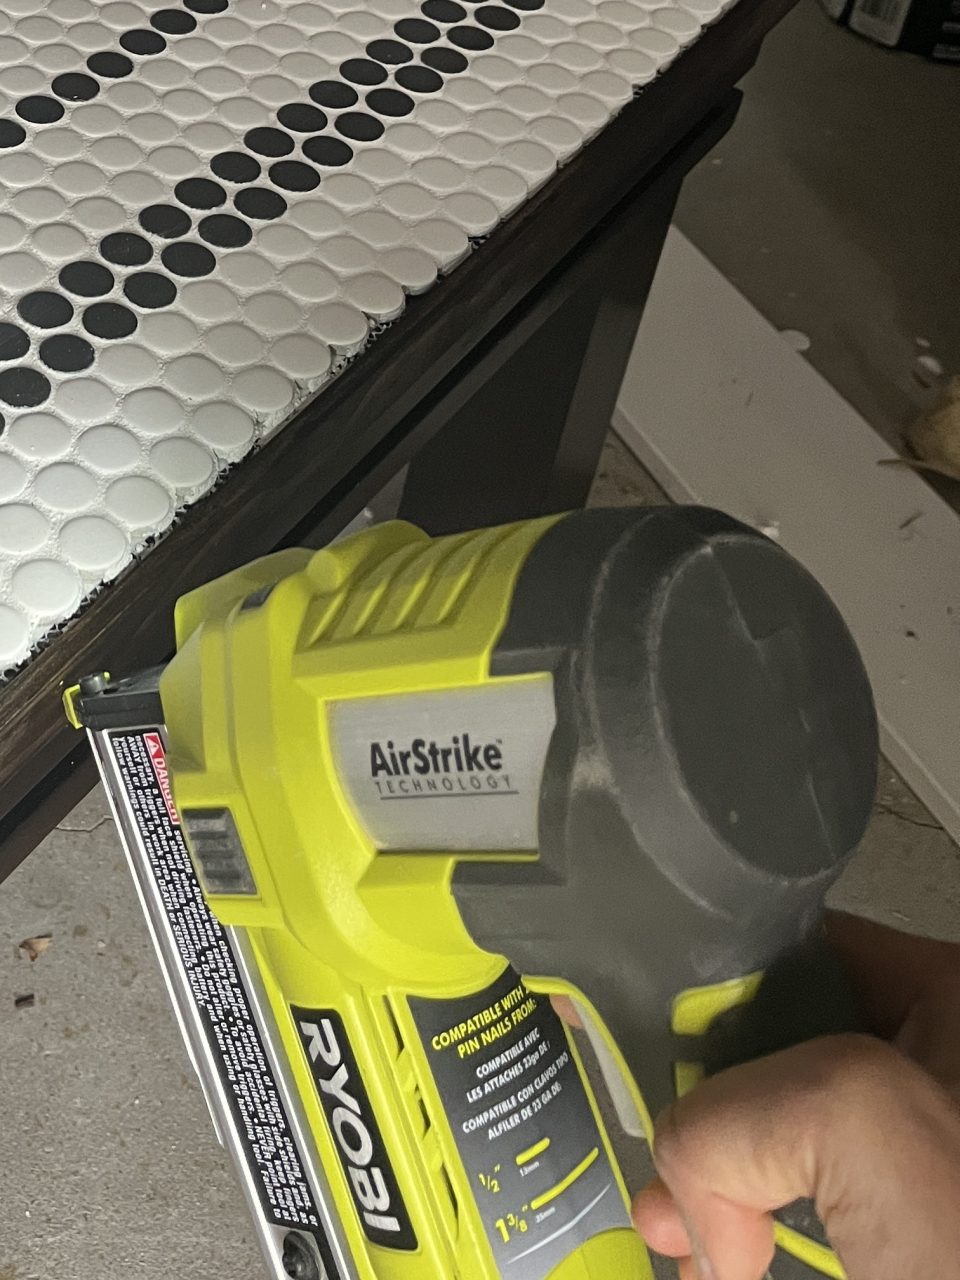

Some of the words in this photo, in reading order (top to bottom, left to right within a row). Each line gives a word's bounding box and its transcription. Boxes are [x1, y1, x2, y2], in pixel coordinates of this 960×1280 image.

[112, 737, 125, 765] follow
[121, 767, 139, 809] warnings
[135, 811, 150, 836] could
[144, 838, 159, 865] result
[154, 867, 161, 877] in
[158, 878, 174, 910] DEATH
[168, 912, 176, 923] or
[172, 924, 192, 967] SERIOUS
[375, 774, 513, 795] TECHNOLOGY
[117, 736, 137, 773] yourself
[132, 776, 140, 786] or
[136, 789, 150, 818] others
[147, 821, 154, 830] in
[151, 833, 164, 856] work
[159, 859, 170, 880] area
[167, 883, 180, 909] when
[176, 911, 197, 963] connecting
[194, 966, 210, 1000] battery
[206, 1003, 218, 1022] and
[213, 1024, 226, 1051] when
[223, 1054, 236, 1081] using
[232, 1084, 241, 1095] or
[237, 1097, 255, 1140] handling
[261, 1170, 276, 1205] Failure
[273, 1208, 281, 1218] to
[127, 736, 142, 763] AWAY
[136, 765, 148, 786] from
[144, 788, 160, 824] triggers
[156, 826, 169, 852] when
[165, 853, 176, 869] not
[171, 870, 186, 904] driving
[201, 963, 210, 977] Do
[206, 979, 218, 995] not
[212, 996, 224, 1020] alter
[220, 1022, 228, 1032] or
[224, 1034, 241, 1071] remove
[254, 1125, 271, 1159] NEVER
[264, 1161, 280, 1187] point
[275, 1188, 287, 1208] tool
[282, 1209, 291, 1220] at
[155, 797, 166, 813] full
[161, 816, 172, 837] face
[169, 840, 184, 869] shield
[180, 872, 192, 898] when
[189, 901, 208, 947] operating
[205, 950, 216, 969] this
[230, 1026, 238, 1037] To
[235, 1040, 249, 1068] avoid
[245, 1071, 267, 1122] accidental
[274, 1159, 286, 1184] keep
[283, 1187, 298, 1222] fingers
[432, 1003, 503, 1050] COMPATIBLE
[501, 986, 524, 1011] WITH
[457, 1037, 480, 1058] PIN
[481, 1017, 512, 1046] NAILS
[511, 998, 537, 1026] FROM:
[192, 886, 208, 920] Always
[204, 921, 216, 946] wear
[212, 947, 227, 977] safety
[221, 979, 240, 1017] goggles
[236, 1019, 244, 1030] or
[240, 1031, 254, 1062] safety
[249, 1063, 267, 1101] glasses
[263, 1103, 277, 1124] with
[271, 1125, 283, 1148] side
[278, 1149, 295, 1185] shields
[299, 1211, 308, 1224] as
[218, 940, 237, 983] checking
[232, 987, 249, 1020] proper
[246, 1024, 266, 1071] operation
[263, 1075, 273, 1086] of
[283, 1136, 301, 1178] clearing
[308, 1214, 317, 1226] or
[462, 1095, 517, 1133] COMPATIBLE
[517, 1084, 534, 1102] CON
[534, 1063, 557, 1090] CLAVOS
[466, 1086, 483, 1103] LES
[484, 1061, 523, 1094] ATTACHES
[476, 1041, 524, 1078] COMPATIBLE
[524, 1027, 540, 1048] AVEC
[488, 1113, 521, 1140] ALFILER
[521, 1105, 533, 1121] DE
[532, 1098, 542, 1113] 23
[541, 1090, 552, 1105] GA
[299, 1018, 401, 1232] RYOBI
